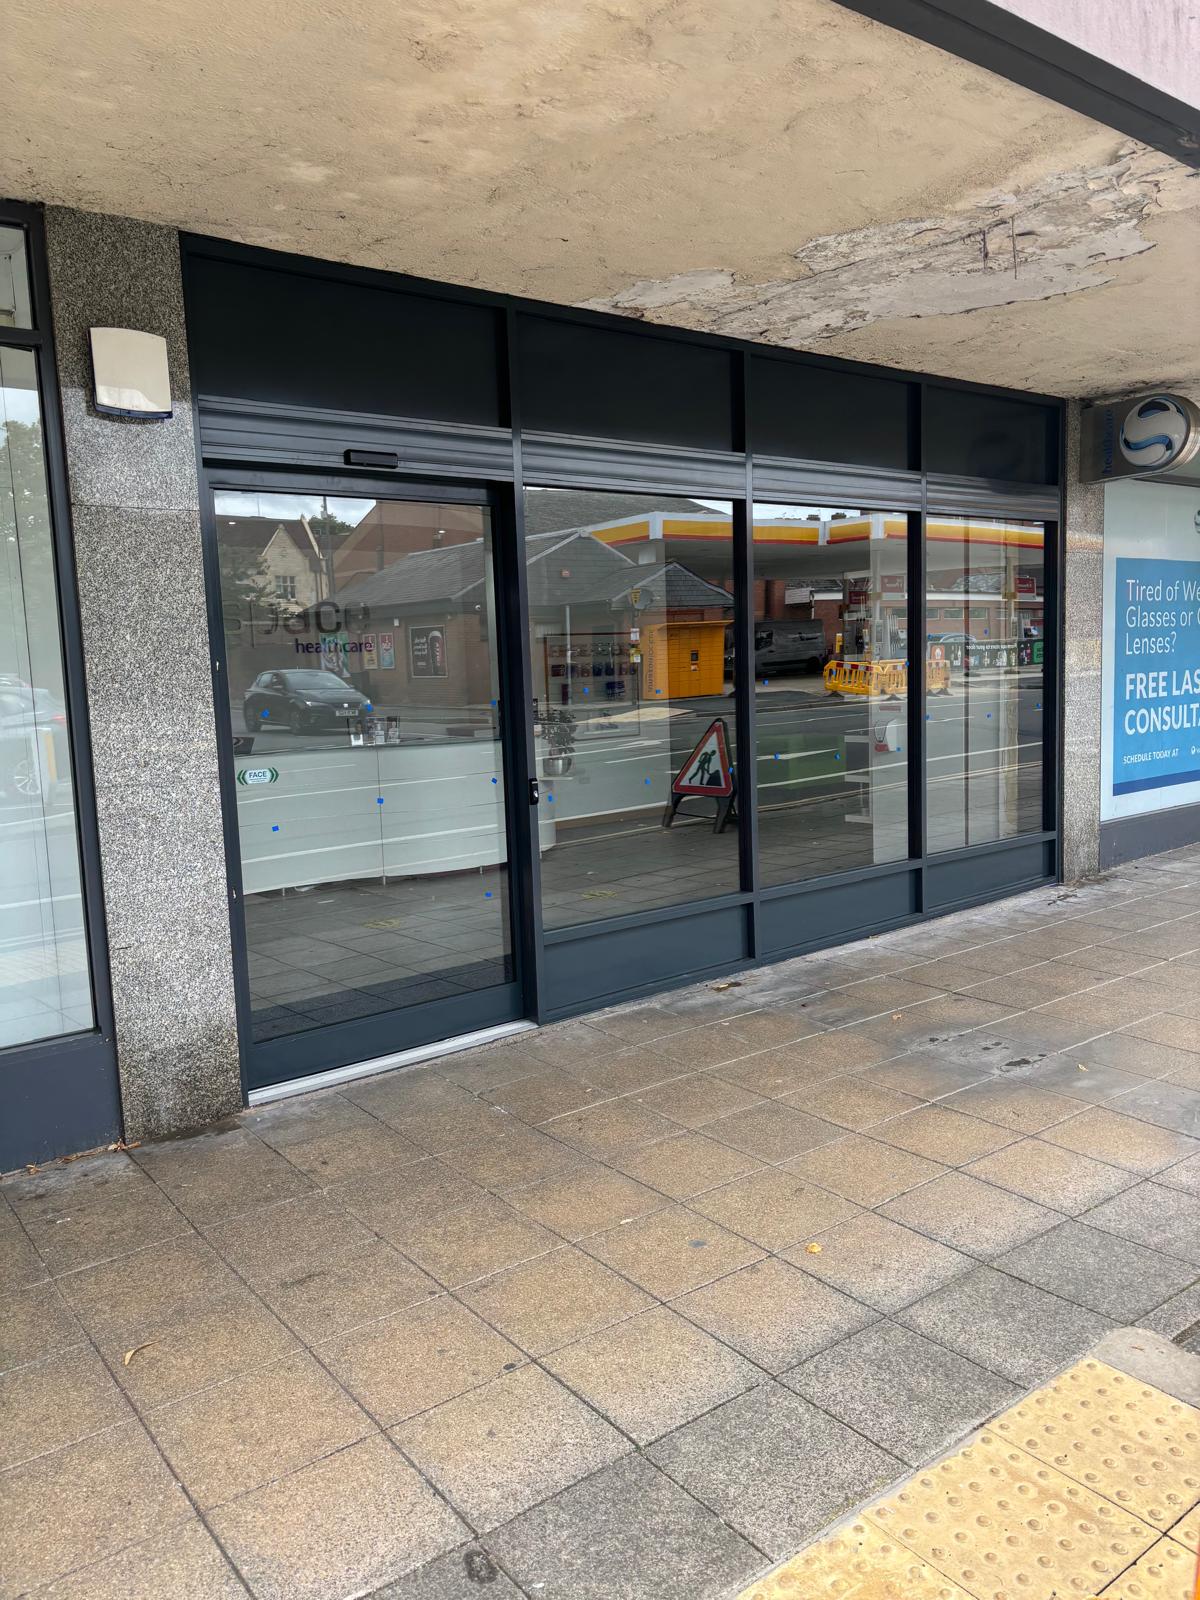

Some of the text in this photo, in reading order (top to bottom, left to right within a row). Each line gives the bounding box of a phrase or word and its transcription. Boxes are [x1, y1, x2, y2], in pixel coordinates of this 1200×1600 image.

[1126, 579, 1162, 601] Tired
[1166, 580, 1180, 602] of
[1126, 605, 1177, 628] Glasses
[1180, 611, 1194, 628] or
[294, 638, 373, 654] healthcare
[1126, 631, 1177, 656] Lenses?
[1126, 672, 1168, 700] FREE
[1124, 703, 1200, 736] CONSULT
[1123, 748, 1180, 765] SCHEDULE TODAY AT
[248, 771, 268, 779] FACE
